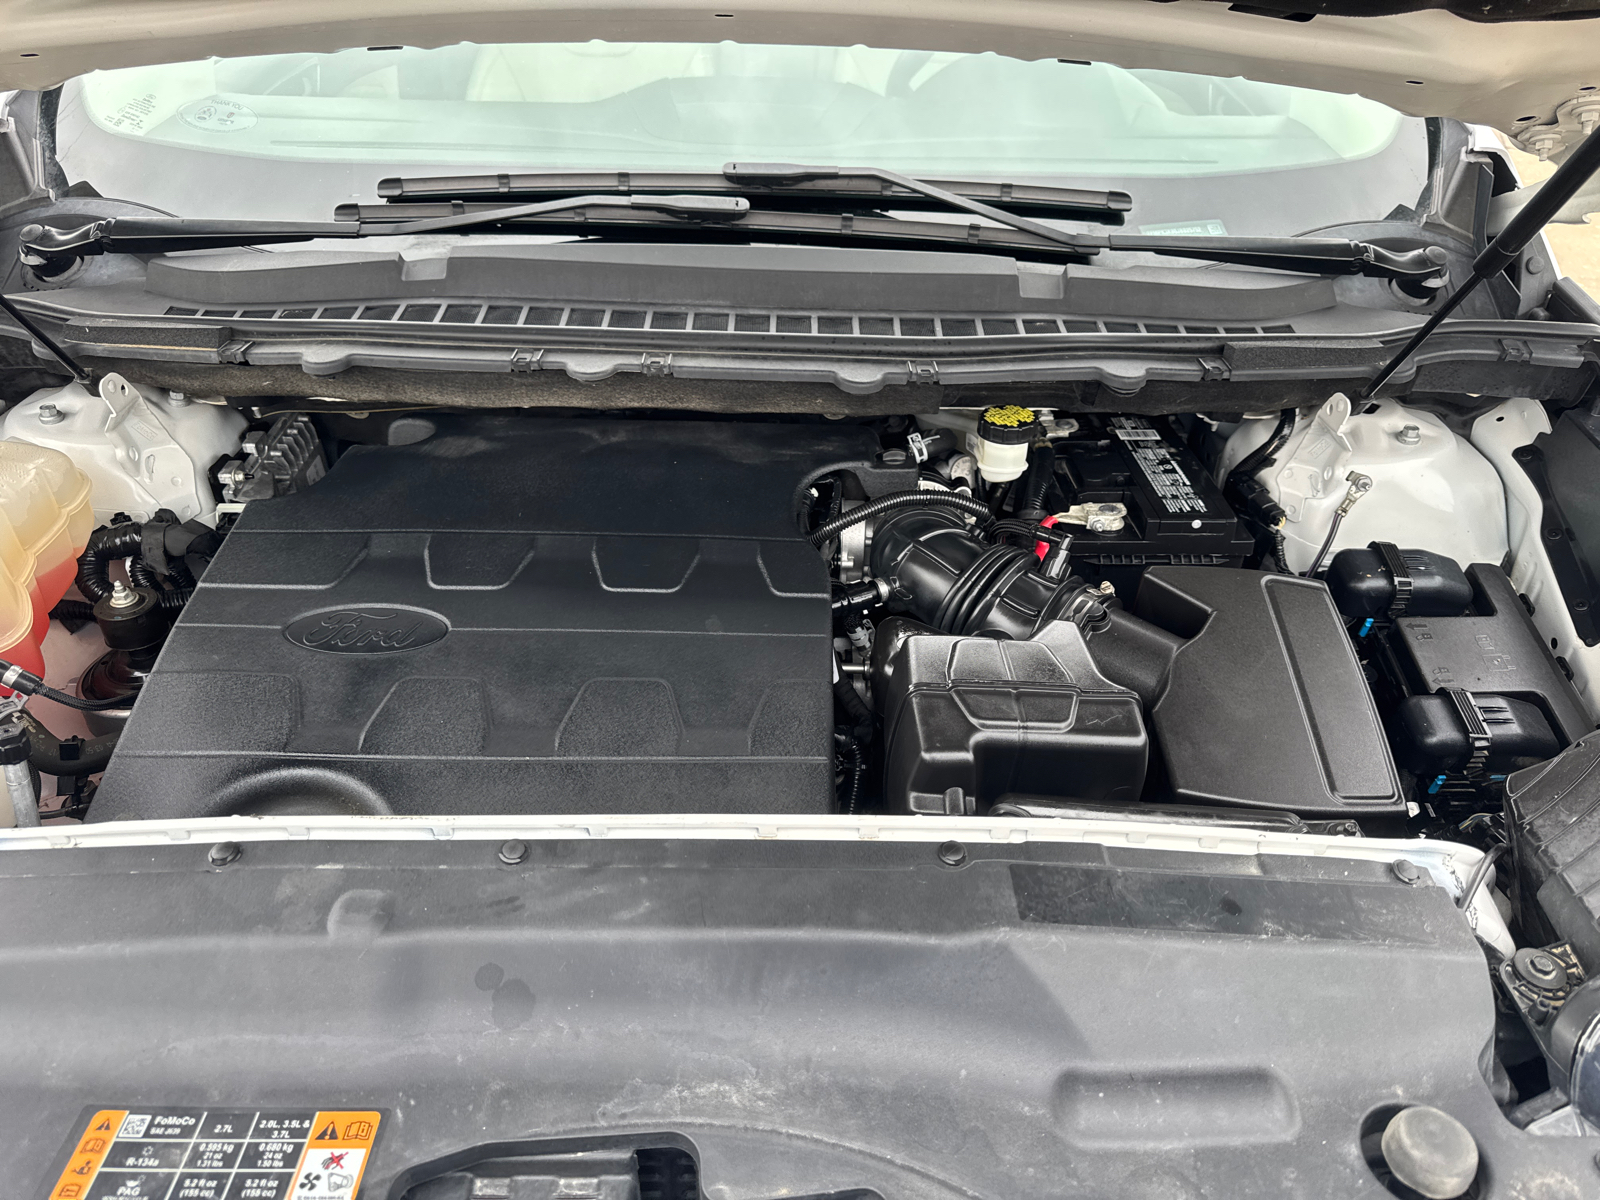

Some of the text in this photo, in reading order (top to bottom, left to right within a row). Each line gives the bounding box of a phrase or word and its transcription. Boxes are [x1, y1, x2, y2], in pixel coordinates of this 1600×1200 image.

[211, 99, 244, 111] THANK YOU
[303, 611, 422, 646] Ford
[154, 1116, 196, 1126] FoMoCo
[282, 1119, 301, 1129] 3.5L
[302, 1119, 310, 1128] &
[150, 1127, 165, 1135] SAE
[213, 1124, 233, 1133] 2.7L
[271, 1130, 290, 1139] 3.7L
[199, 1143, 234, 1154] 0.595 kg
[258, 1143, 294, 1154] 0.680 kg
[125, 1157, 160, 1167] R-134a
[183, 1179, 198, 1188] 5.2
[206, 1180, 218, 1188] oz
[244, 1179, 259, 1188] 5.2
[267, 1180, 279, 1188] oz
[116, 1186, 141, 1196] PAG
[179, 1188, 215, 1198] (155 cc)
[241, 1188, 277, 1198] (155 cc)
